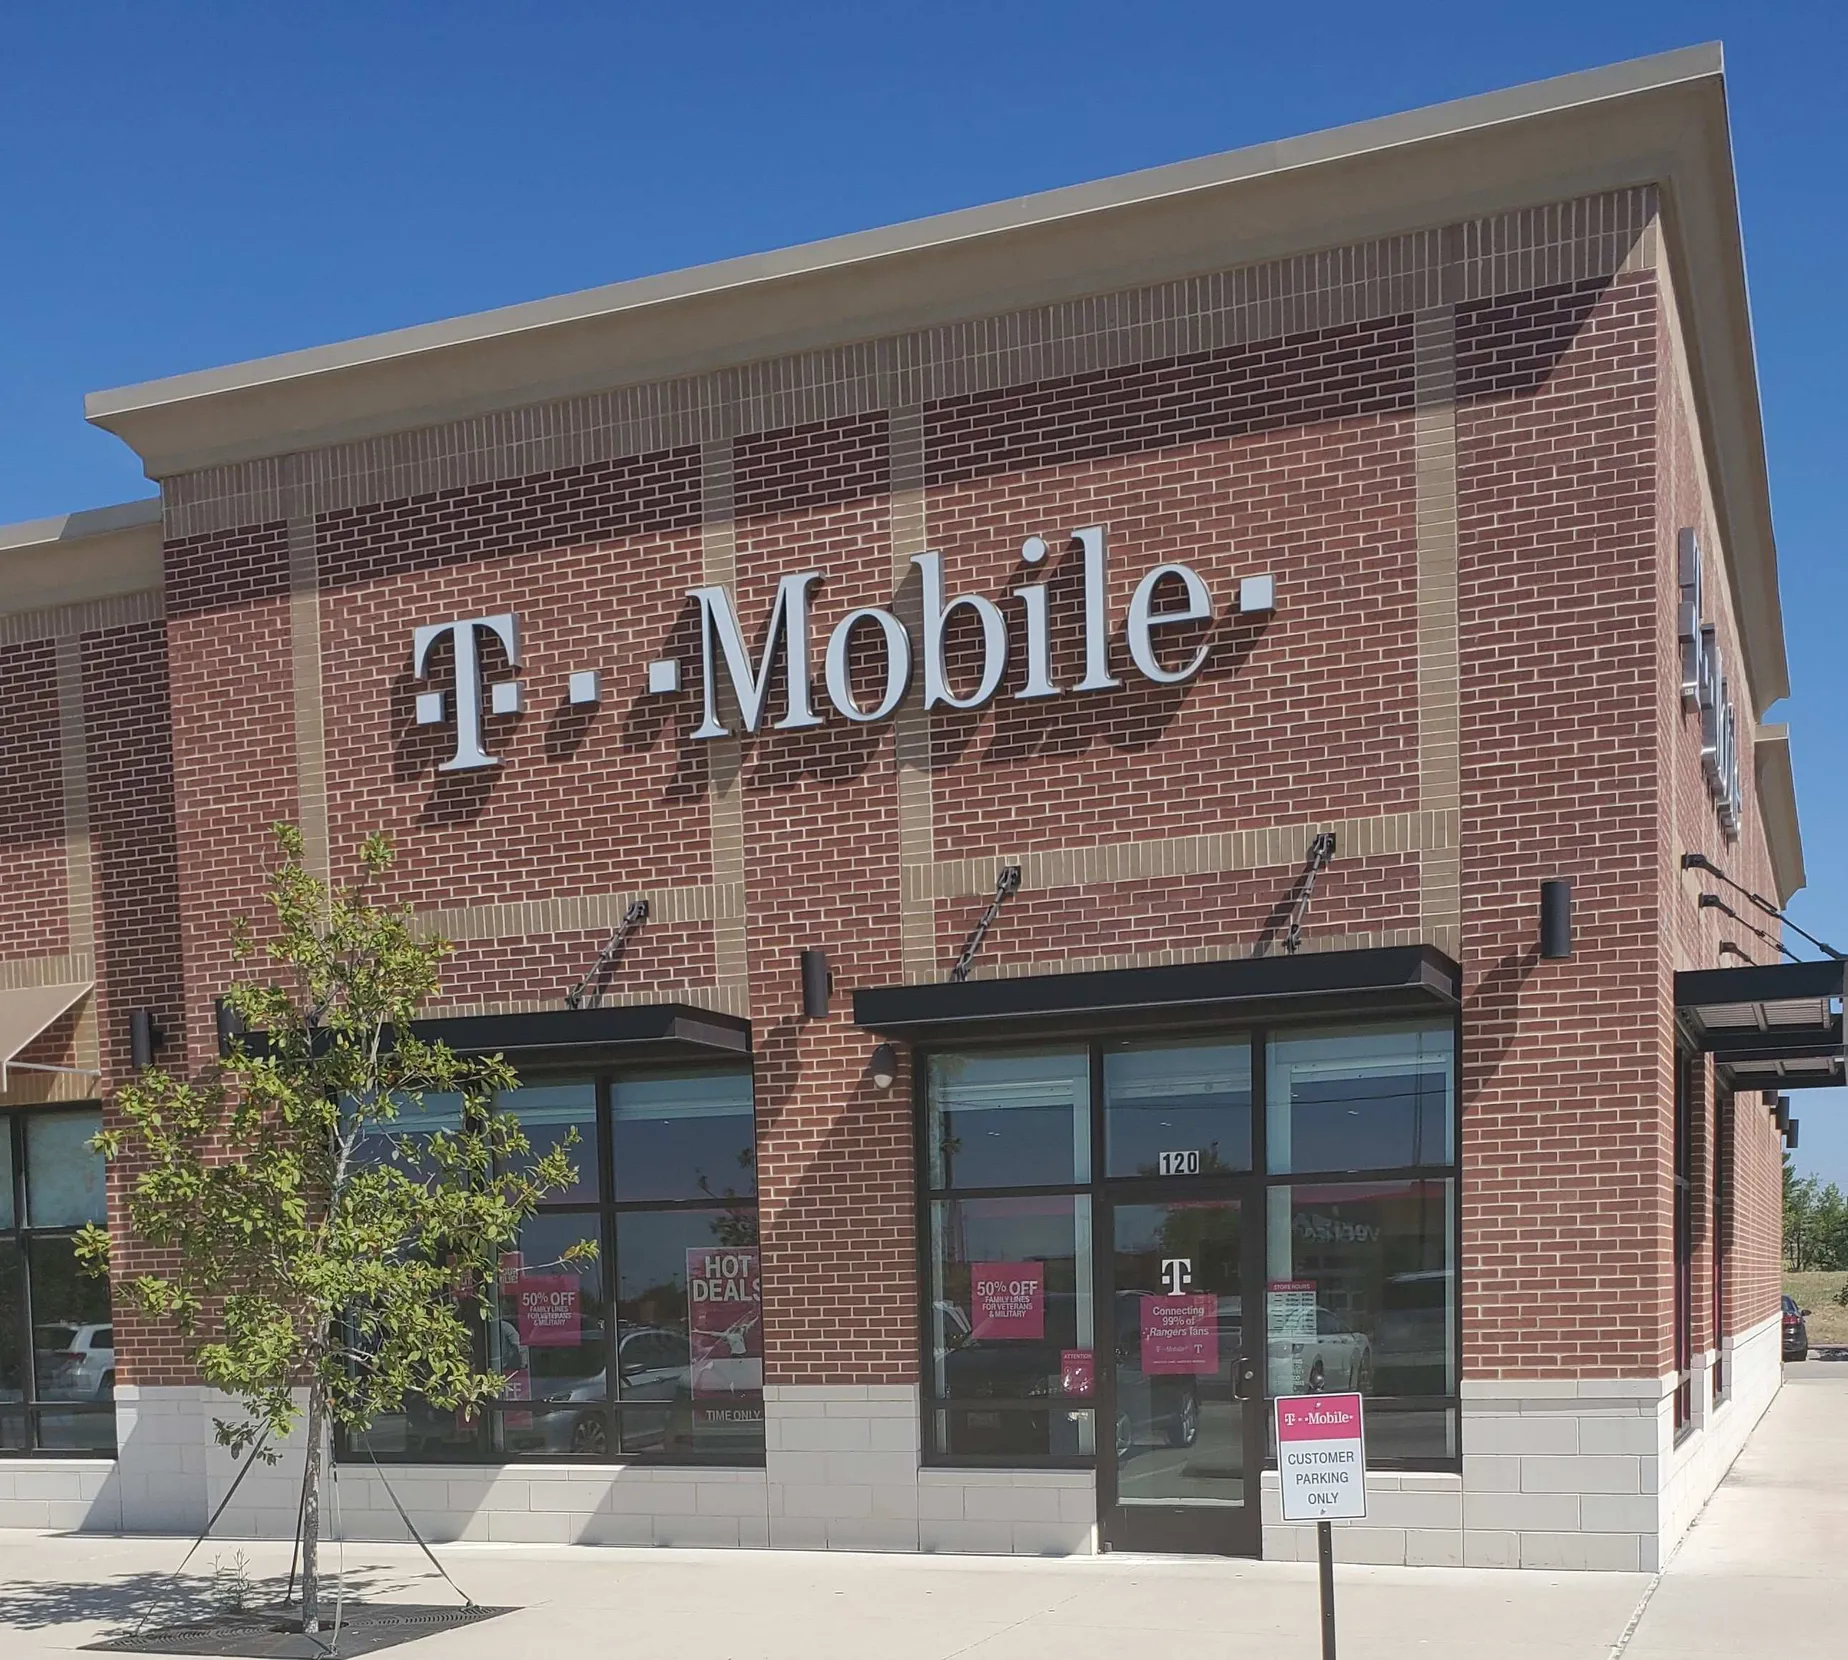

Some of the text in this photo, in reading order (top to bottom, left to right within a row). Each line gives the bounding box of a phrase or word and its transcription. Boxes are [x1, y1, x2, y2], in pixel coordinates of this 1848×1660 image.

[1163, 1152, 1197, 1174] 120
[705, 1255, 752, 1278] HOT
[1162, 1259, 1191, 1296] T
[976, 1281, 1038, 1296] 50% OFF
[522, 1292, 576, 1306] 50% OFF
[985, 1295, 1009, 1303] FAMILY
[982, 1303, 997, 1311] FOR
[1152, 1305, 1205, 1318] Connecting
[1162, 1315, 1195, 1326] 99% of
[1149, 1325, 1209, 1338] Rangers fans
[706, 1409, 761, 1421] TIME ONLY
[1287, 1451, 1355, 1465] CUSTOMER
[1296, 1471, 1349, 1485] PARKING
[1307, 1492, 1339, 1504] ONLY
